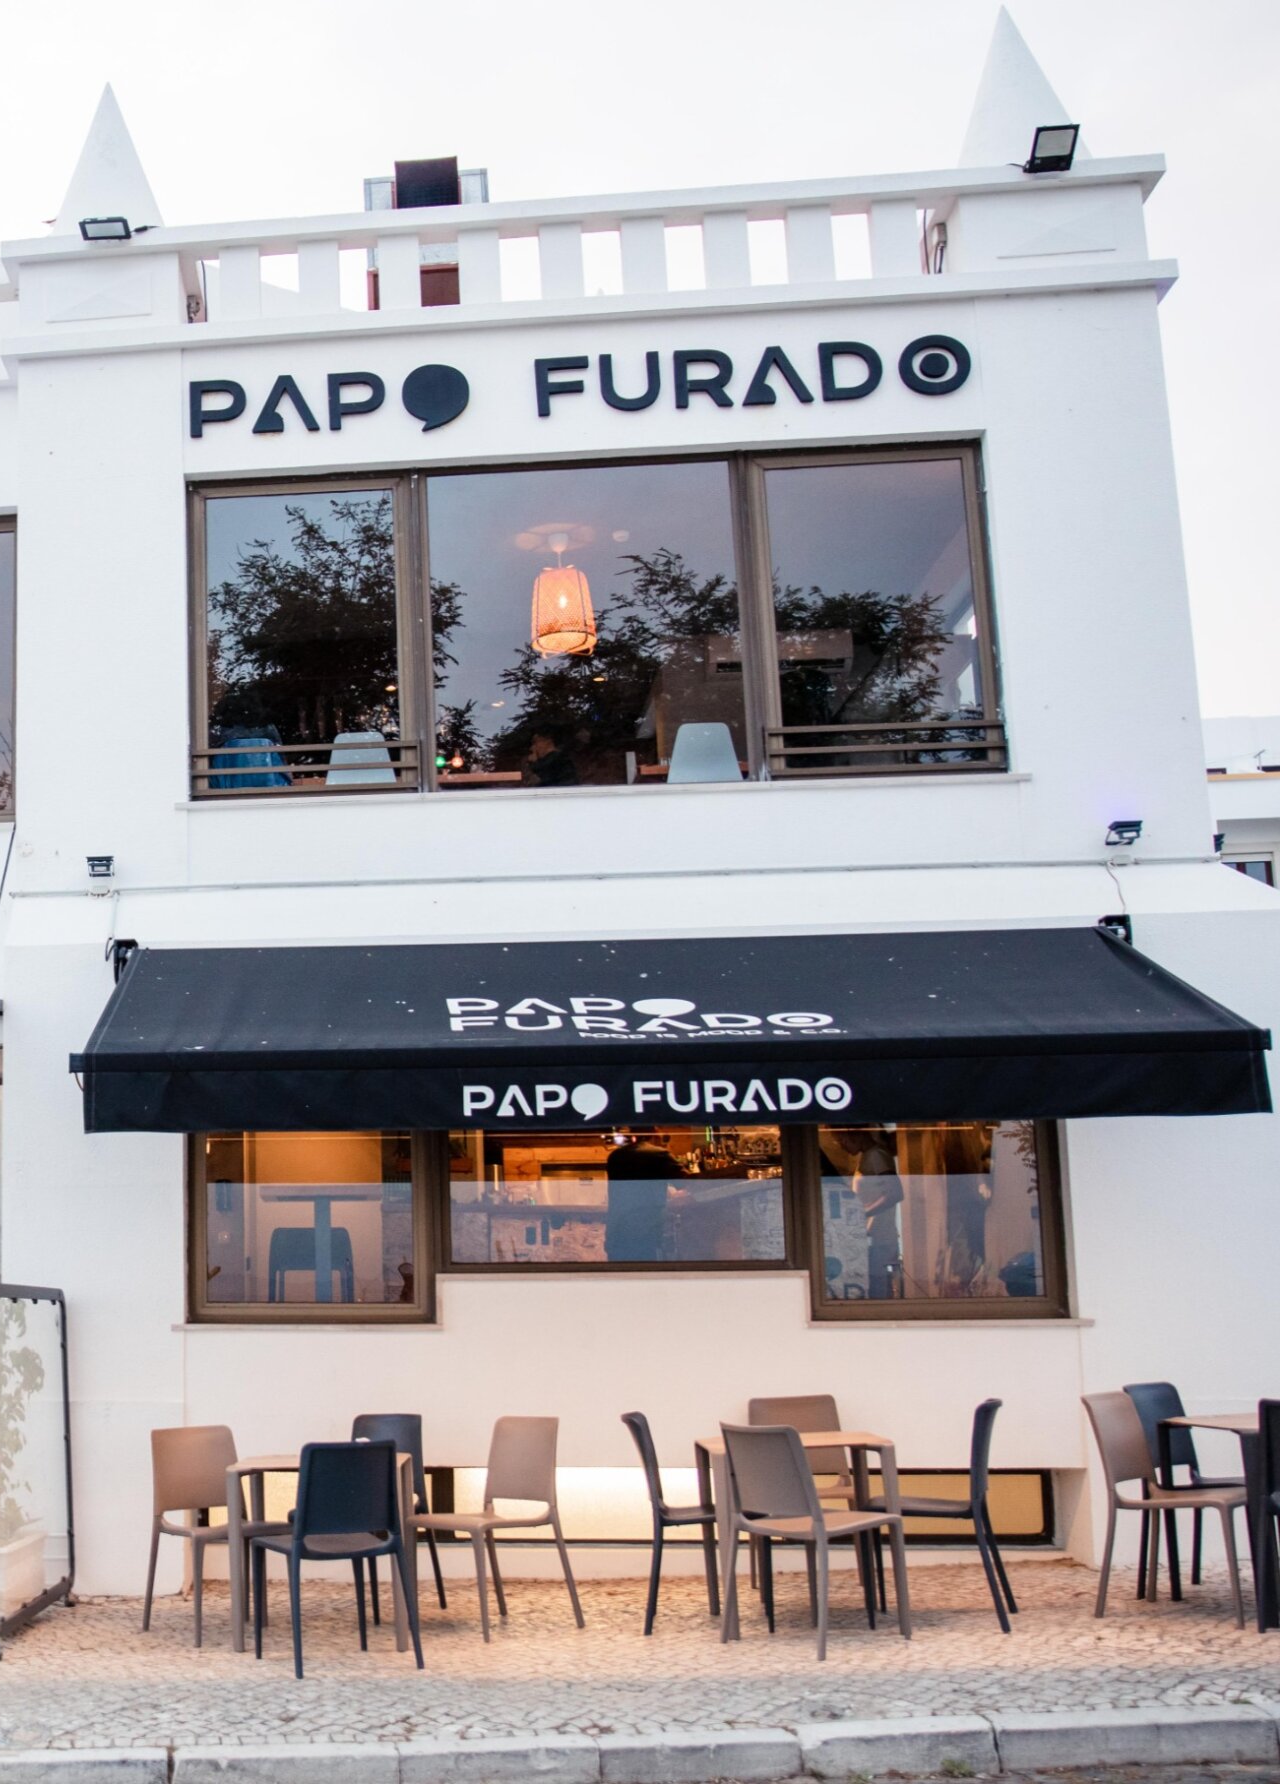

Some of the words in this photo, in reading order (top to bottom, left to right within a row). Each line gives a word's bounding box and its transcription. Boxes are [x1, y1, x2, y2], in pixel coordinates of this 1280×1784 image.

[534, 334, 971, 418] FURADO
[449, 1011, 834, 1033] FURADO
[579, 1031, 648, 1040] FOOD
[687, 1029, 764, 1038] MOOD
[633, 1077, 852, 1113] FURADO
